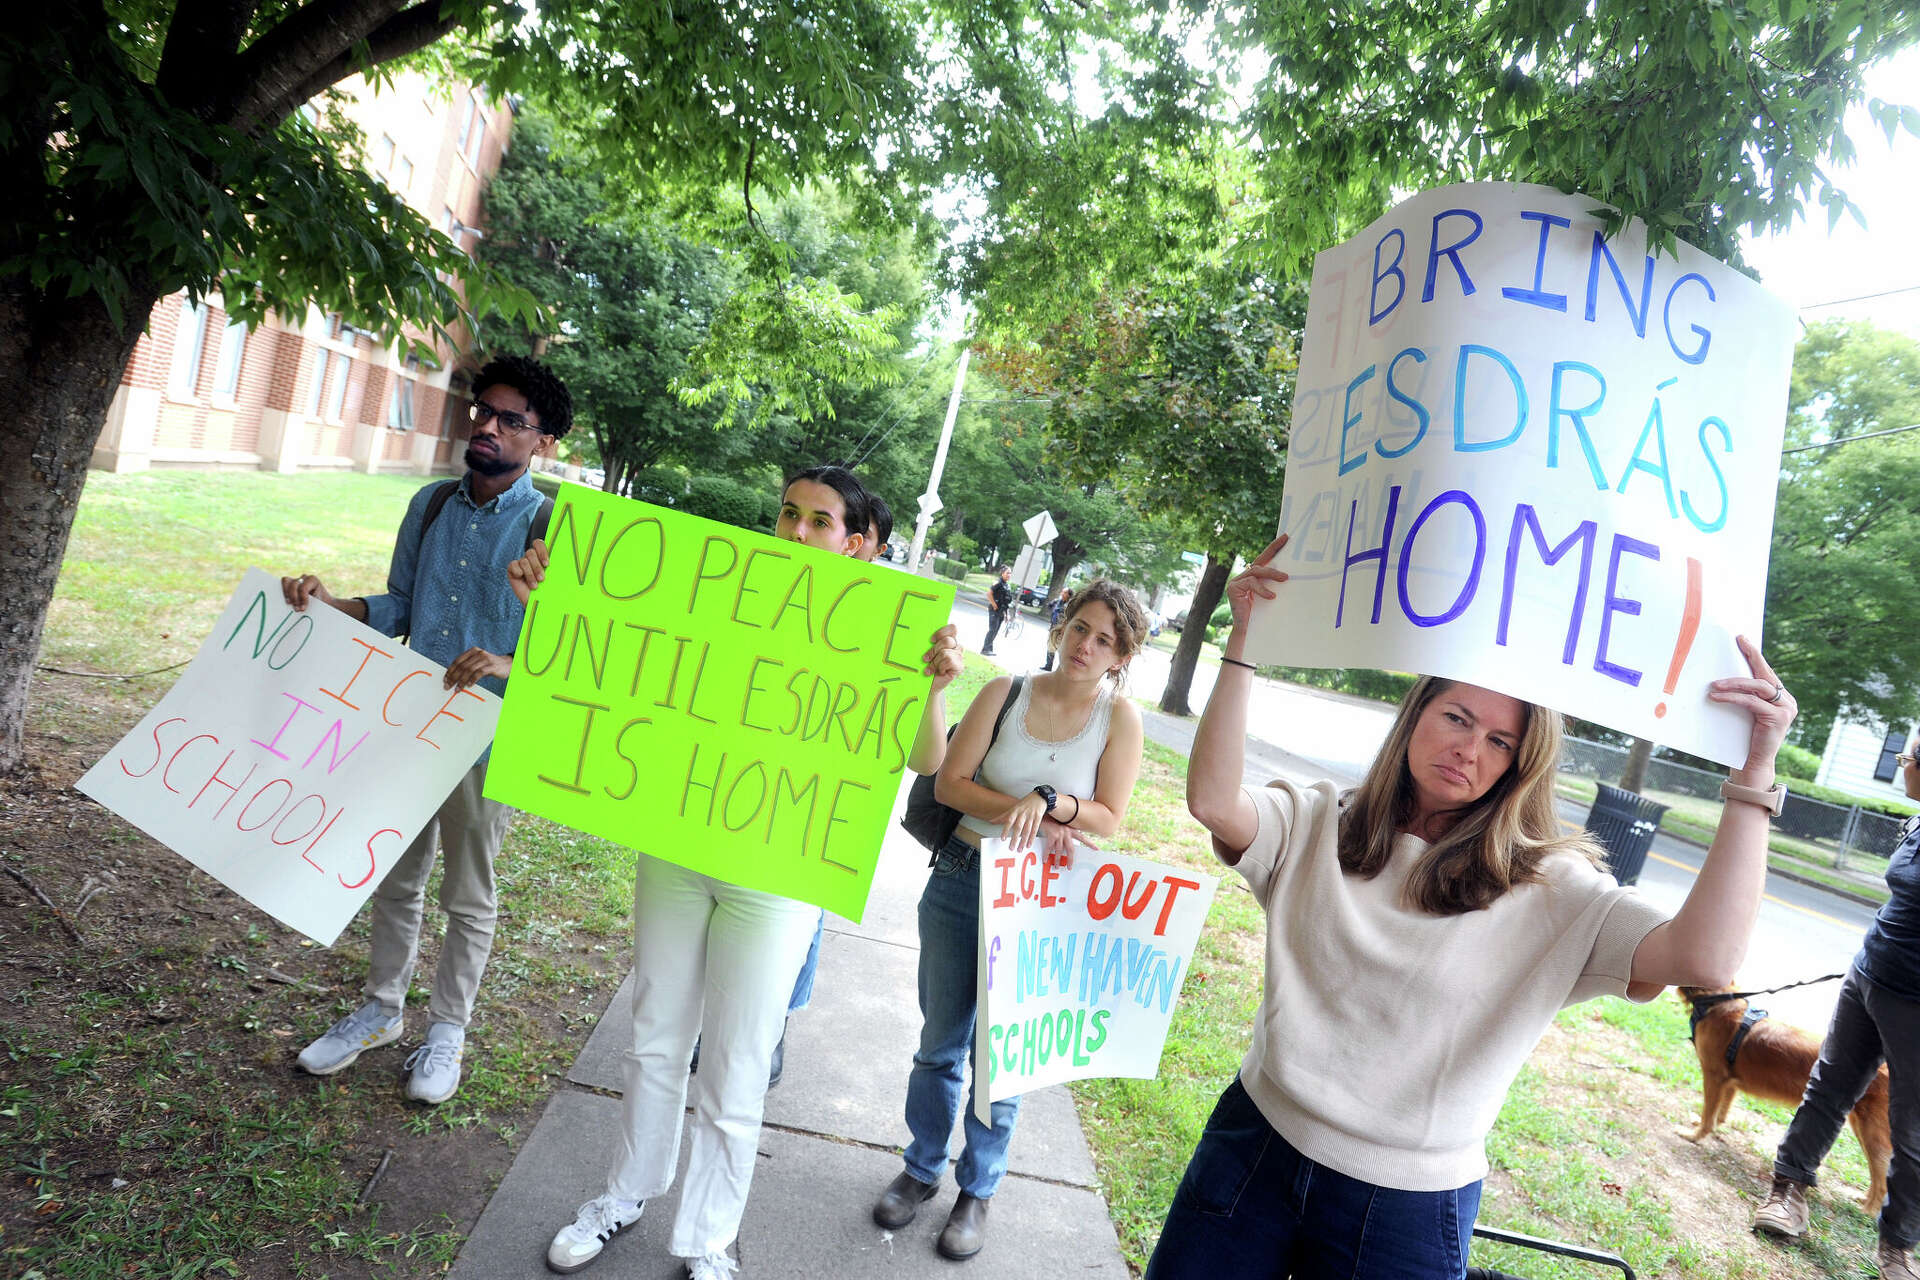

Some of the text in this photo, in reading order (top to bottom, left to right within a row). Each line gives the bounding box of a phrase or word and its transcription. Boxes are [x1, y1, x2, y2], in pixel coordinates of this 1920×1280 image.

[1369, 208, 1716, 365] BRING
[1338, 344, 1733, 534] ESDRÁS
[223, 590, 485, 750] NO ICE
[547, 502, 939, 674] NO PEACE
[1335, 485, 1702, 719] HOME!
[249, 692, 370, 775] IN
[523, 600, 919, 774] UNTIL ESDRÁS
[120, 717, 402, 889] SCHOOLS
[537, 694, 872, 876] IS HOME
[1016, 930, 1077, 1004] NEW
[1079, 931, 1182, 1014] HAVEN
[1086, 863, 1200, 936] OUT
[988, 1008, 1111, 1085] SCHOOLS
